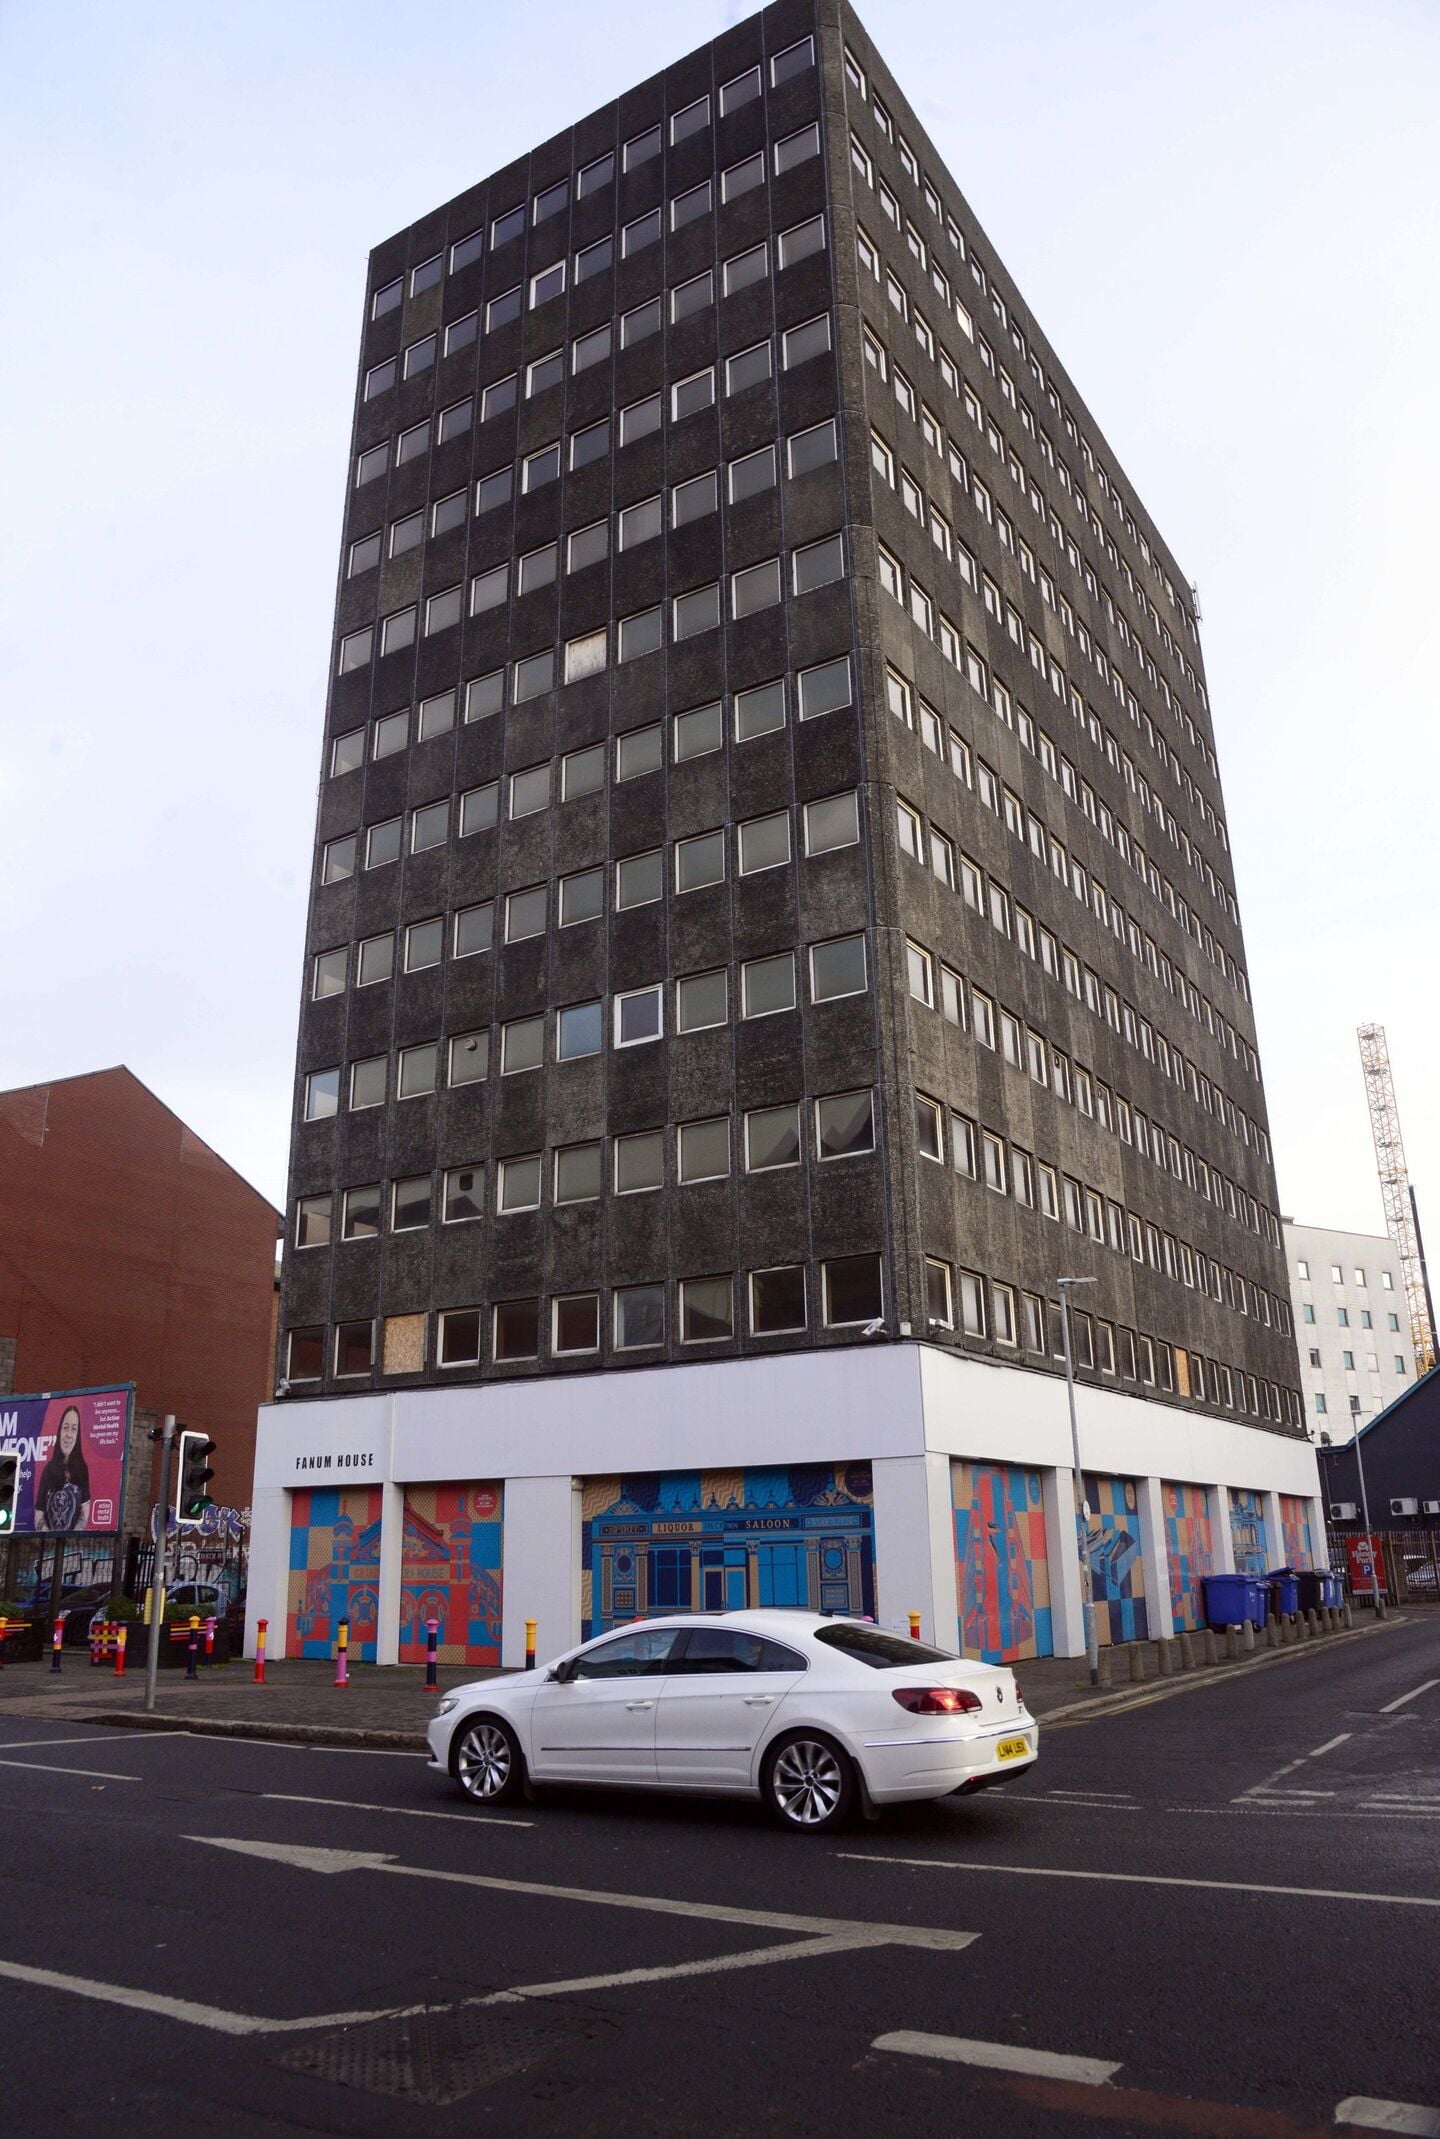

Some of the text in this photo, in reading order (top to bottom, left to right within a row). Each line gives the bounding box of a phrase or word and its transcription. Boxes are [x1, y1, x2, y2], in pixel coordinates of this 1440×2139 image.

[296, 1453, 374, 1470] FANUM HOUSE
[657, 1523, 695, 1532] LIQUOR
[745, 1519, 791, 1529] SALOON
[416, 1566, 445, 1579] HOUSE
[1363, 1565, 1371, 1575] P
